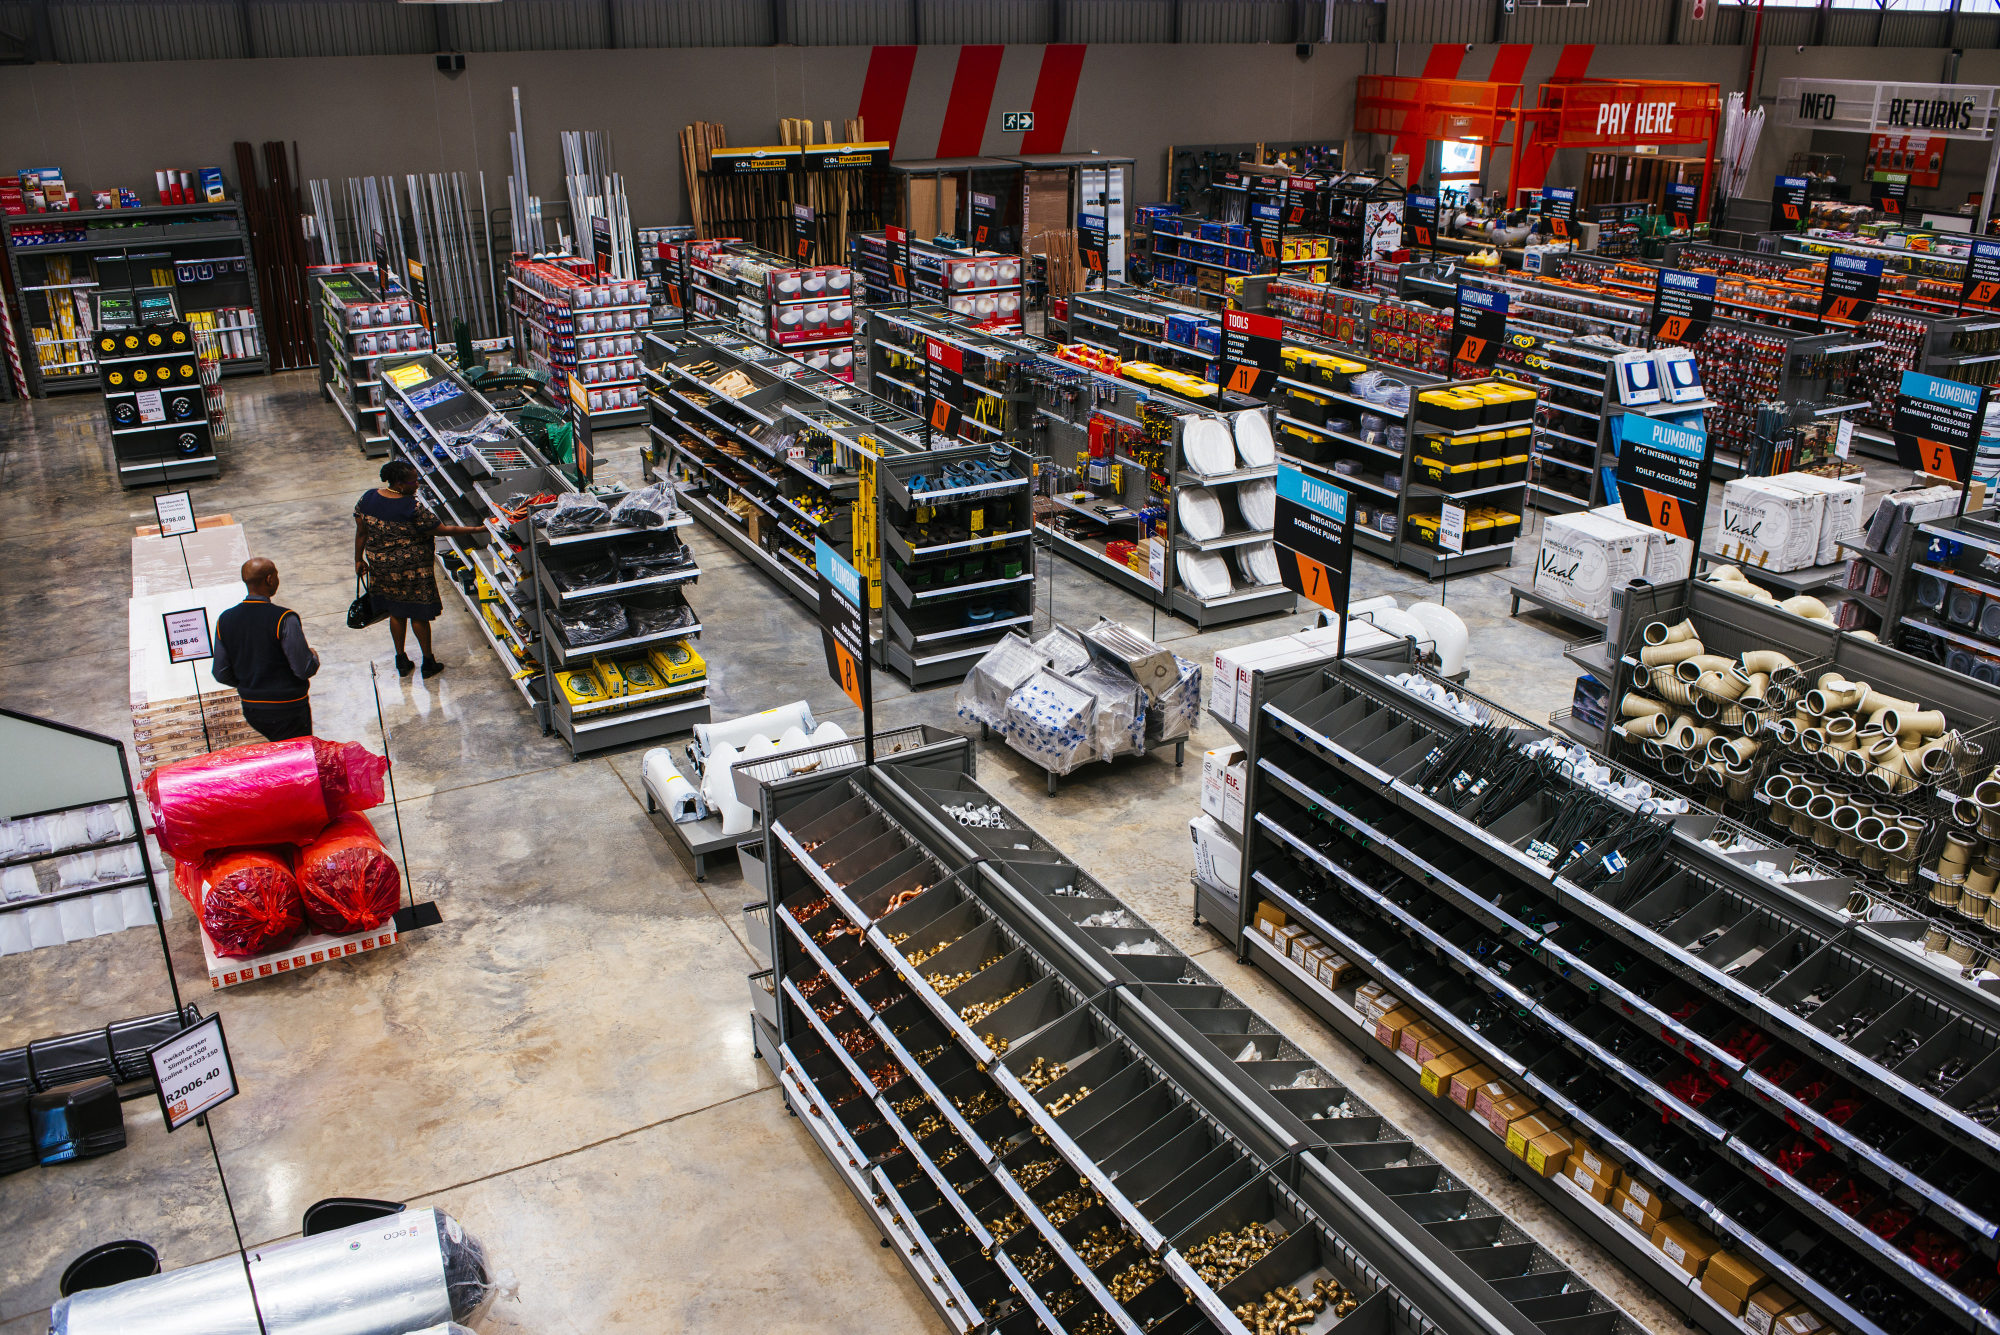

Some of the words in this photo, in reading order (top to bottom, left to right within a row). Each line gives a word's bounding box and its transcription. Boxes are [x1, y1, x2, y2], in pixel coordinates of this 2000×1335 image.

[1799, 92, 1836, 120] INFO
[1888, 98, 1974, 130] RETURNS
[1596, 102, 1631, 135] PAY
[1634, 102, 1677, 134] HERE
[1556, 221, 1562, 233] 15
[1834, 256, 1867, 271] HARDWARE
[1664, 272, 1699, 288] HARDWARE
[1462, 288, 1494, 306] HARDWARE
[1687, 292, 1712, 301] ACCESSORIES
[1980, 284, 1991, 299] 15
[1460, 313, 1476, 321] WELDING
[1837, 300, 1847, 315] 14
[1228, 314, 1249, 330] TOOLS
[1670, 320, 1679, 336] 13
[1228, 333, 1249, 342] SPANNERS
[1228, 340, 1245, 348] CUTTERS
[929, 342, 942, 360] TOOLS
[1467, 340, 1476, 359] 12
[1241, 358, 1257, 366] DRIVERS
[1240, 370, 1247, 389] 11
[1929, 381, 1977, 405] PLUMBING
[937, 404, 944, 426] 10
[1900, 406, 1931, 419] PLUMBING
[1932, 413, 1971, 429] ACCESSORIES
[1923, 402, 1951, 415] EXTERNAL
[1953, 410, 1972, 420] WASTE
[1652, 425, 1703, 453] PLUMBING
[1931, 423, 1950, 433] TOILET
[1951, 429, 1968, 438] SEATS
[1634, 446, 1647, 454] PVC
[1647, 450, 1677, 463] INTERNAL
[1678, 458, 1700, 469] WASTE
[1932, 448, 1943, 470] 5
[1635, 466, 1655, 477] TOILET
[1656, 472, 1696, 490] ACCESSORIES
[1679, 468, 1698, 479] TRAPS
[1301, 480, 1344, 515] PLUMBING
[1310, 513, 1342, 533] IRRIGATION
[1660, 501, 1671, 526] 6
[1724, 509, 1762, 538] Vaal
[1294, 518, 1322, 536] BOREHOLE
[1323, 530, 1342, 544] PUMPS
[1542, 548, 1579, 580] Vaal
[831, 557, 860, 600] PLUMBING
[1312, 567, 1319, 595] 7
[831, 588, 845, 607] COPPER
[844, 599, 861, 622] FITTINGS
[841, 622, 862, 648] SOLDERING
[852, 620, 861, 634] TAPS
[171, 637, 198, 646] R388.46
[832, 626, 849, 648] PRESSURE
[849, 643, 862, 660] VALVES
[846, 659, 851, 691] 8
[163, 1050, 185, 1065] Kwikot
[186, 1038, 207, 1052] Geyser
[160, 1069, 183, 1084] Ecoline
[189, 1048, 218, 1068] ECO3-150
[168, 1054, 193, 1071] Slimline
[166, 1068, 220, 1105] R2006.40
[384, 1230, 407, 1240] eco
